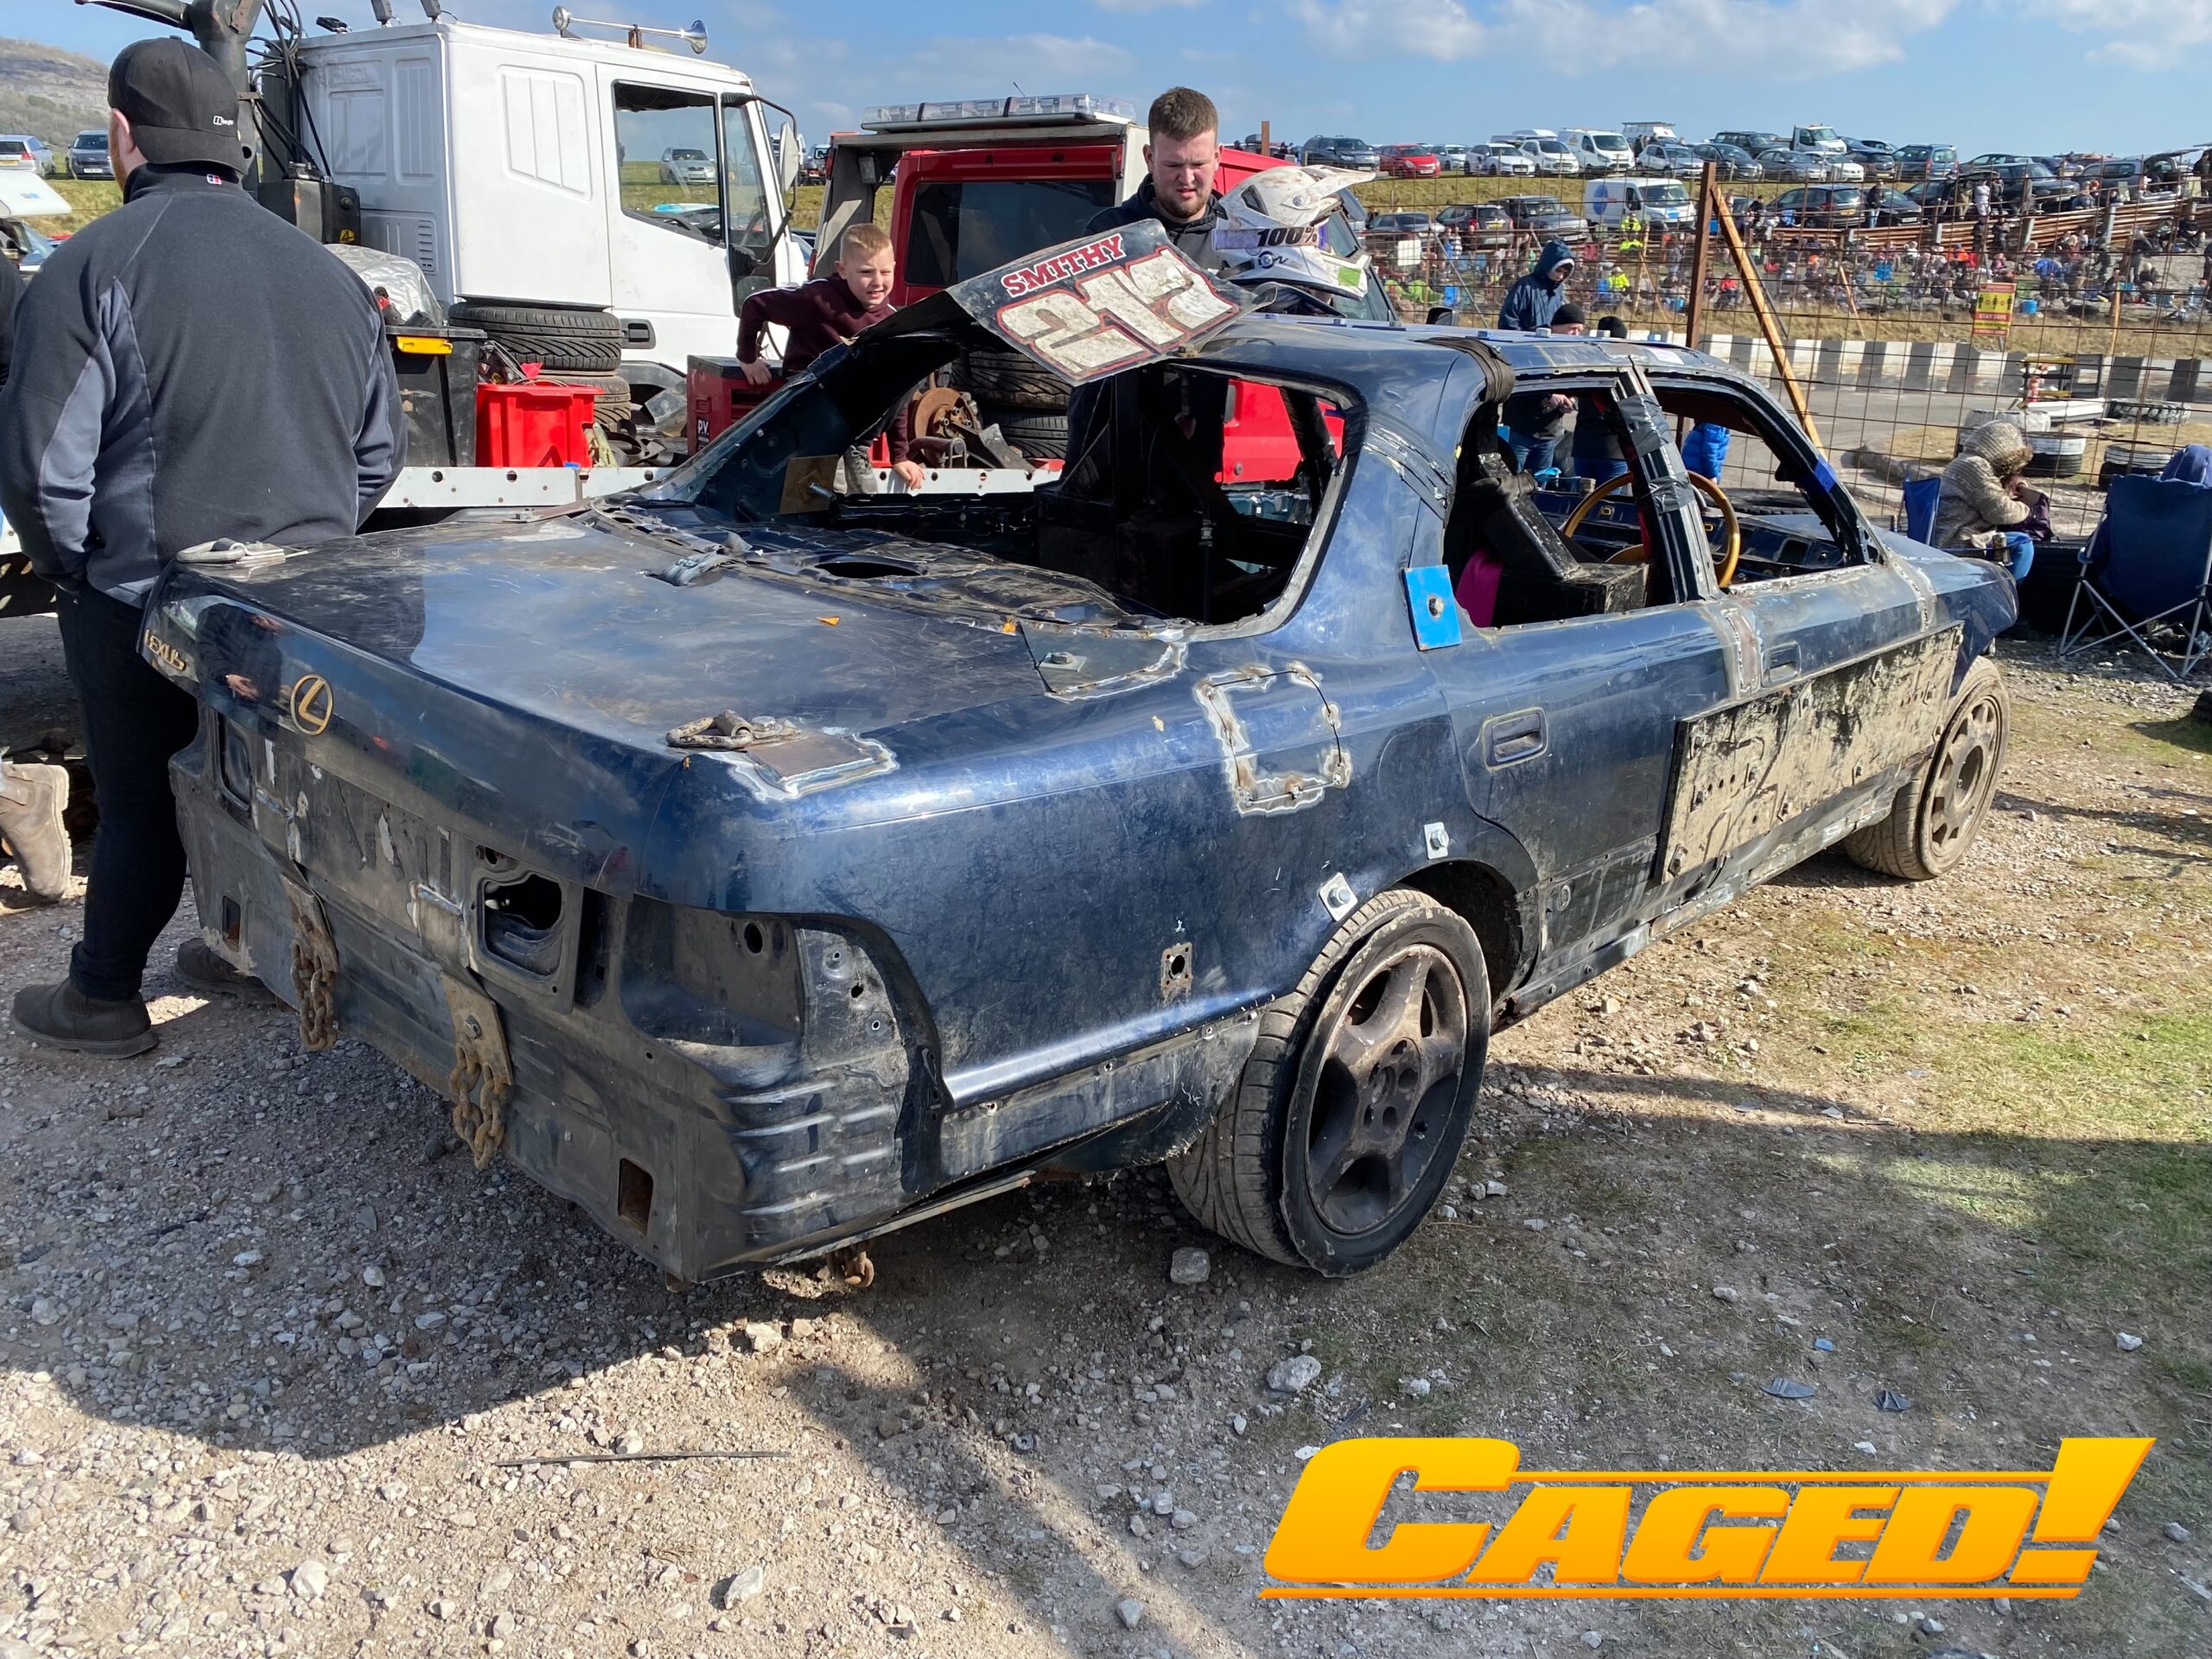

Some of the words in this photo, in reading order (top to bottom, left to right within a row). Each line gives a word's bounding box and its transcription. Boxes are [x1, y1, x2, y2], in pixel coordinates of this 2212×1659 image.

[1257, 226, 1318, 247] 100%
[1001, 233, 1126, 298] SMITHY
[999, 247, 1238, 376] 212
[143, 629, 186, 671] LEXUS
